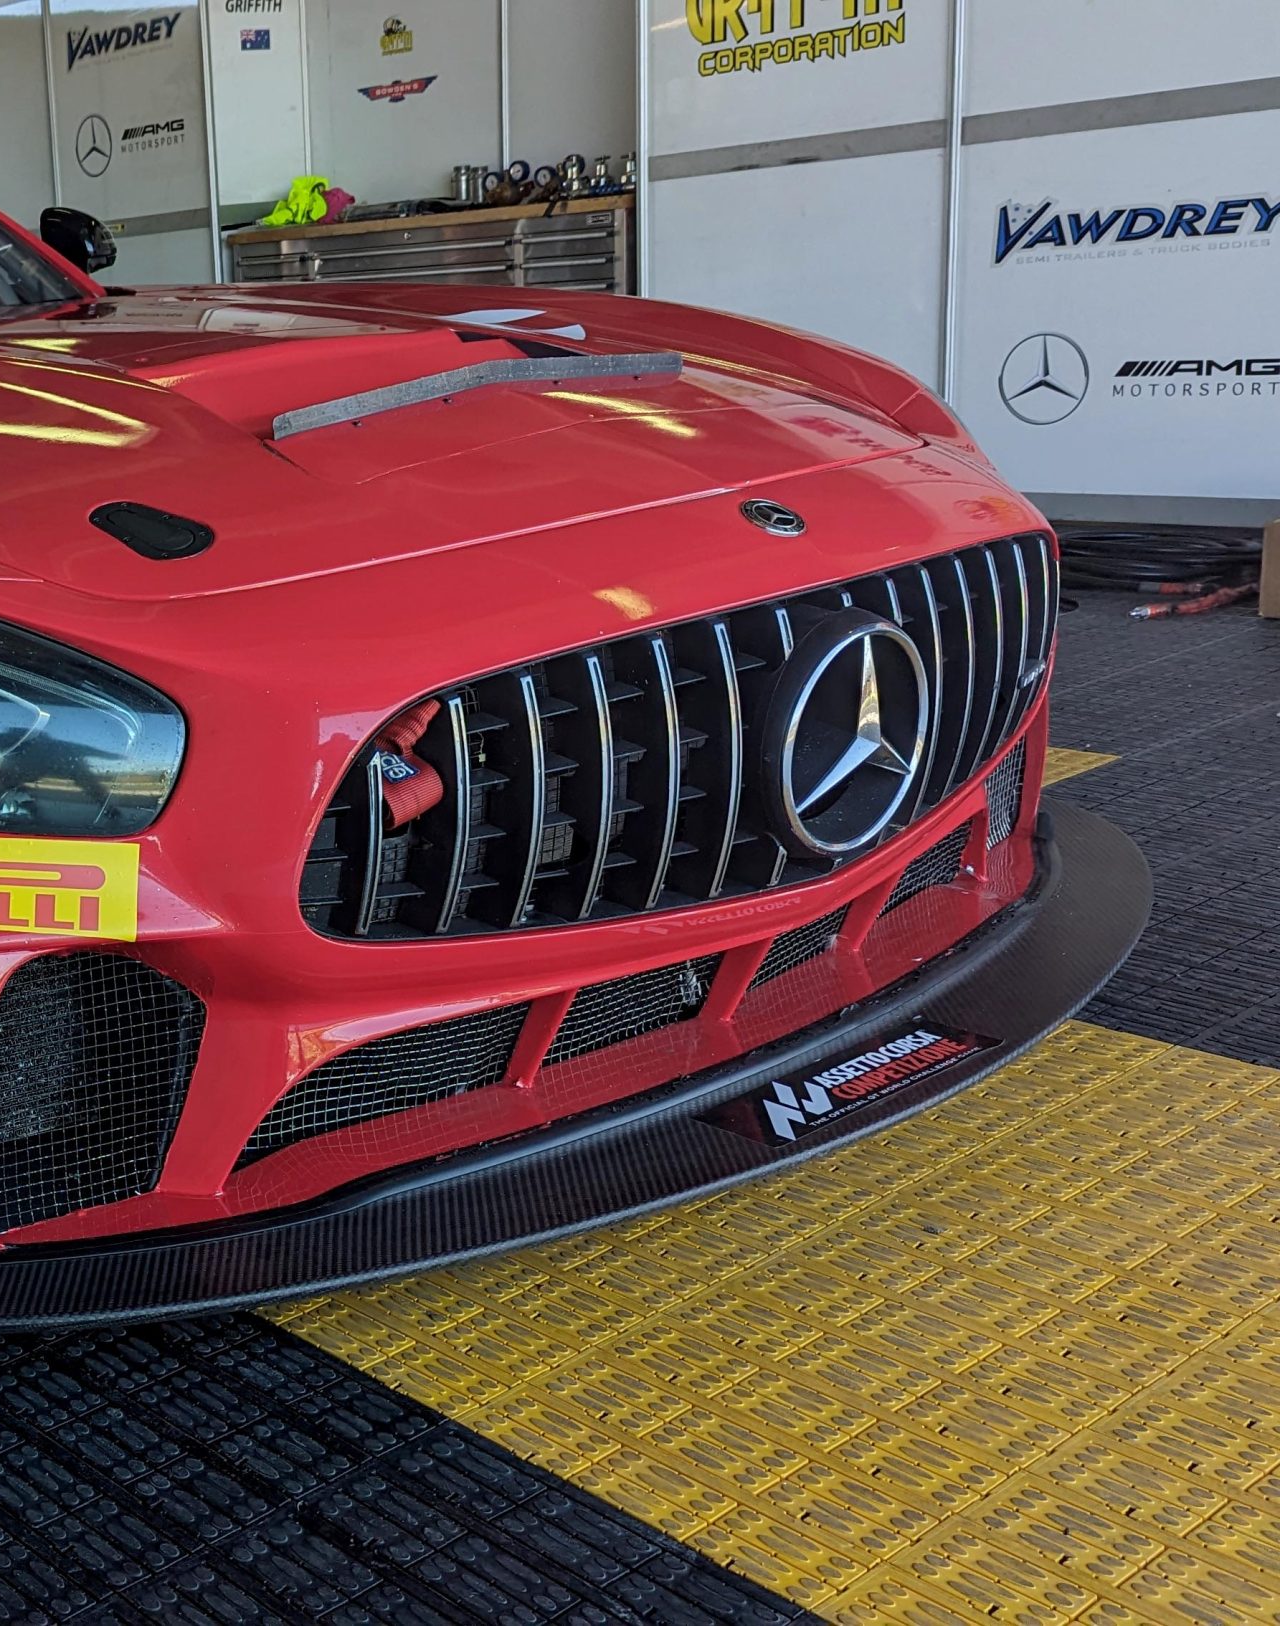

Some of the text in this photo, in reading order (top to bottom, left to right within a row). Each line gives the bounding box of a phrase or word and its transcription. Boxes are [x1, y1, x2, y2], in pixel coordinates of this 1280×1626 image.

[225, 0, 282, 13] GRIFFITH
[67, 12, 181, 72] VAWDREY
[698, 13, 905, 77] CORPORATION
[141, 119, 184, 137] AMG
[121, 134, 185, 153] MOTORSPORT
[994, 198, 1280, 264] VAWDREY
[1016, 256, 1050, 264] SEMI
[1057, 249, 1127, 262] TRAILERS
[1148, 244, 1201, 256] TRUCK
[1208, 238, 1270, 251] BODIES
[1165, 359, 1280, 377] AMG
[1112, 382, 1280, 397] MOTORSPORT
[831, 1038, 967, 1100] COMPETIZIONE
[809, 1115, 830, 1127] THE
[830, 1098, 867, 1118] OFFICIAL
[881, 1079, 911, 1096] WORLD
[910, 1056, 959, 1081] CHALLENGE
